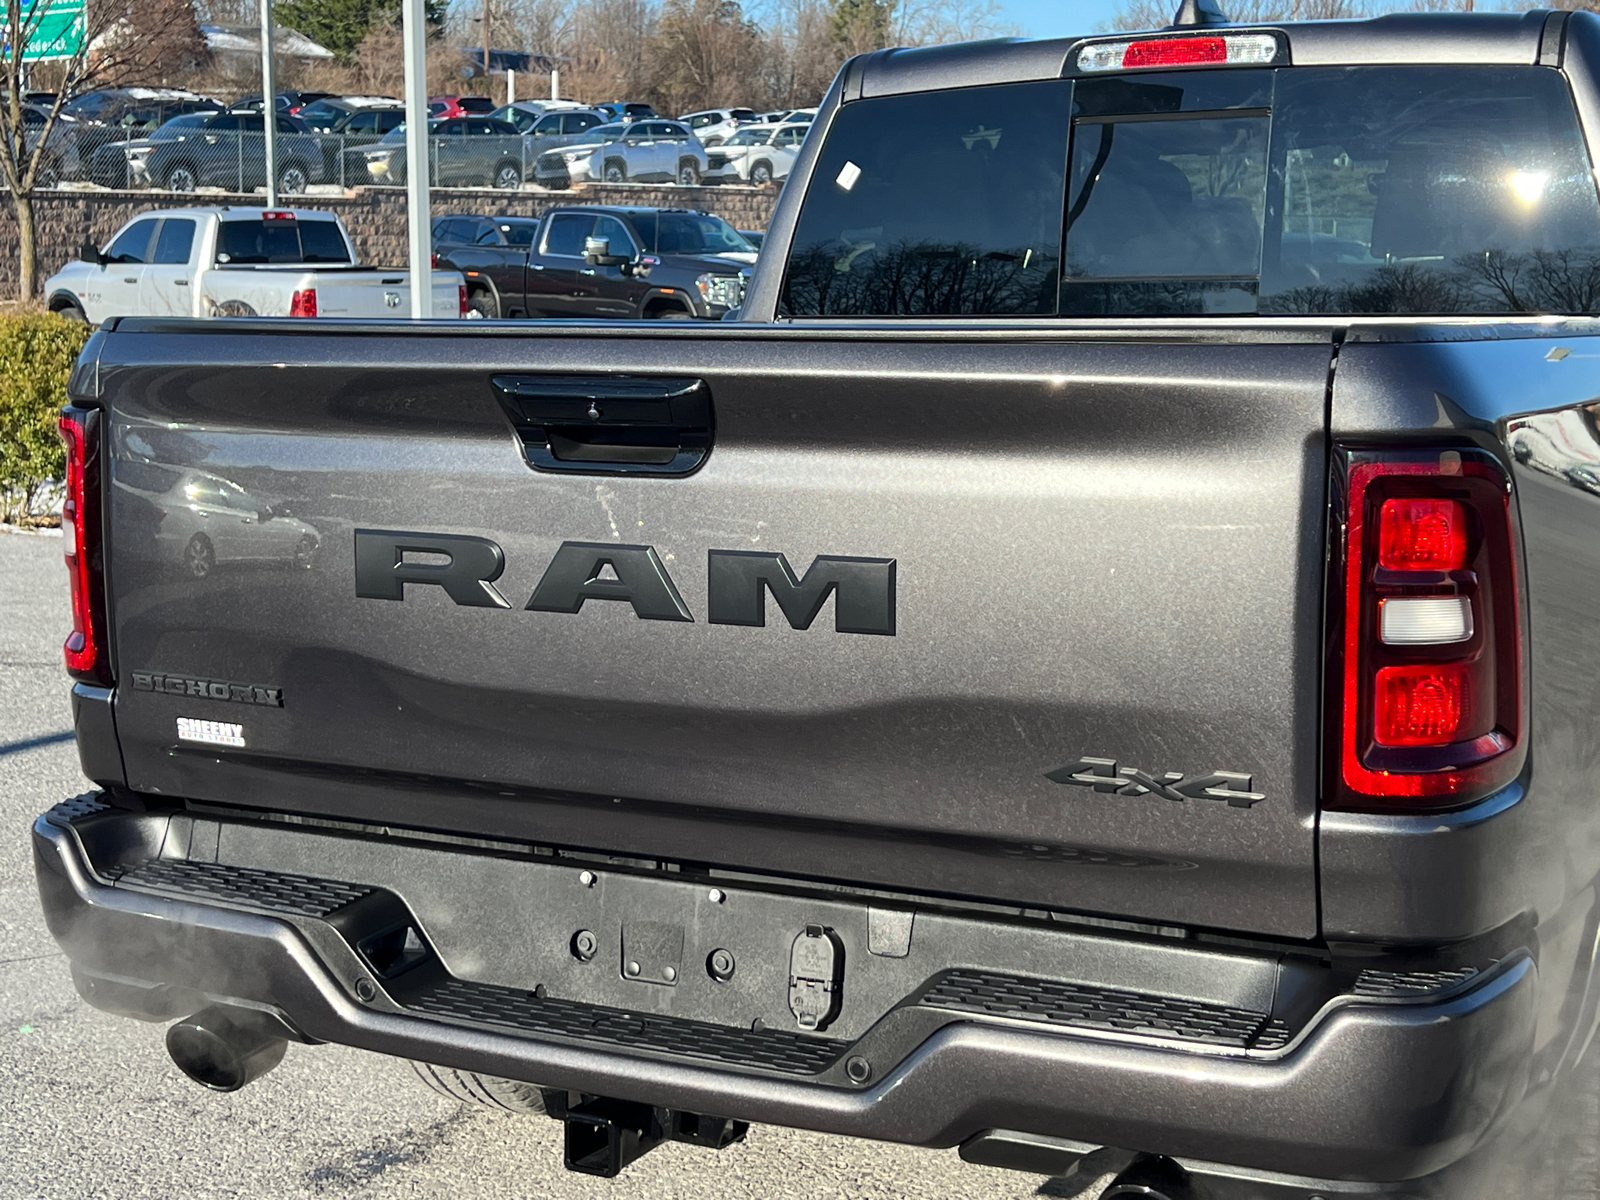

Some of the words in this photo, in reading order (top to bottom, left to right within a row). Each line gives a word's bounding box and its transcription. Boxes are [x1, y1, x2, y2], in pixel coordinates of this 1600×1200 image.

[354, 528, 897, 636] RAM
[131, 670, 284, 708] BIGHORN
[176, 717, 243, 737] SHEEHY
